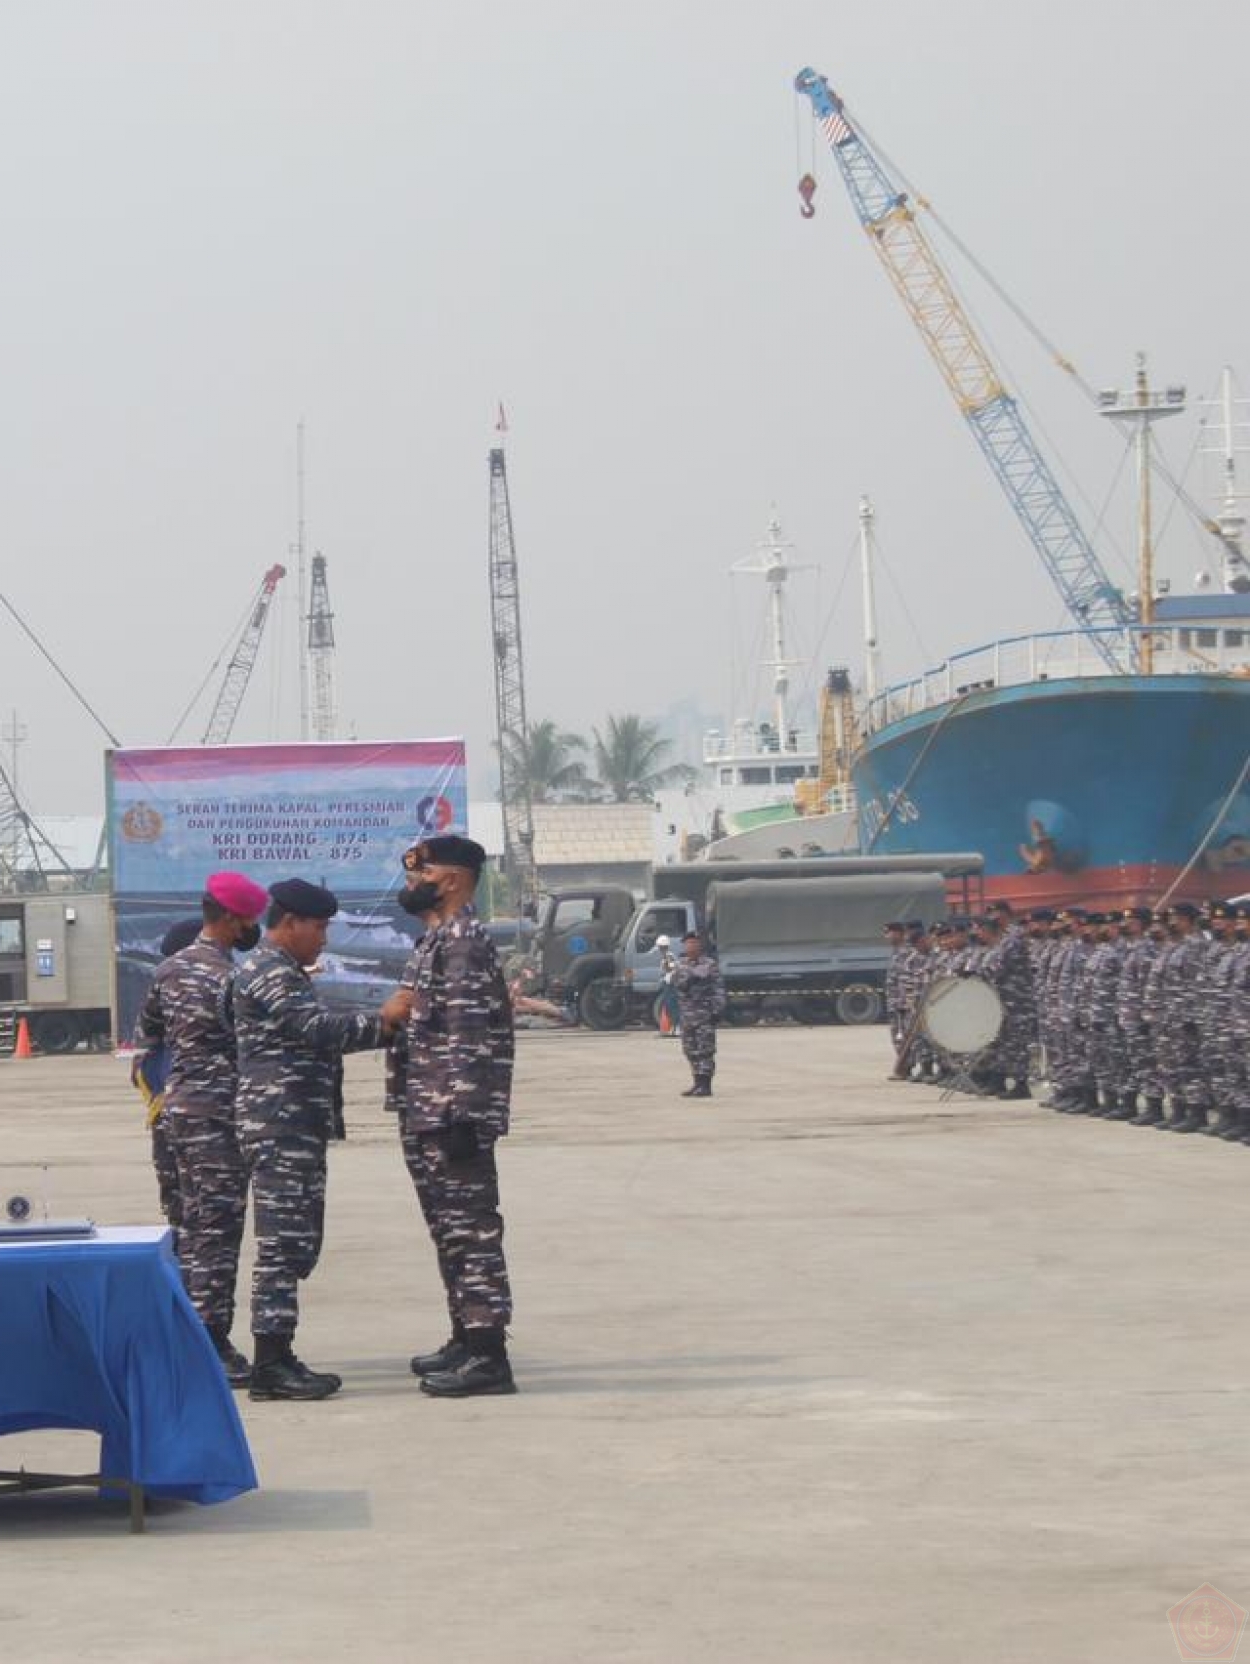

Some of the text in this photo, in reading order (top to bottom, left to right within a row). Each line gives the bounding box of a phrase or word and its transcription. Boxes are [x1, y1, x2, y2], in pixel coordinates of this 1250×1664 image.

[223, 802, 274, 814] TERIMA
[187, 818, 216, 829] DAN
[212, 833, 241, 845] KRI
[247, 833, 318, 845] DORANG
[335, 832, 368, 844] 874
[218, 847, 247, 860] KRI
[253, 847, 312, 860] BAWAL
[330, 847, 363, 860] 875
